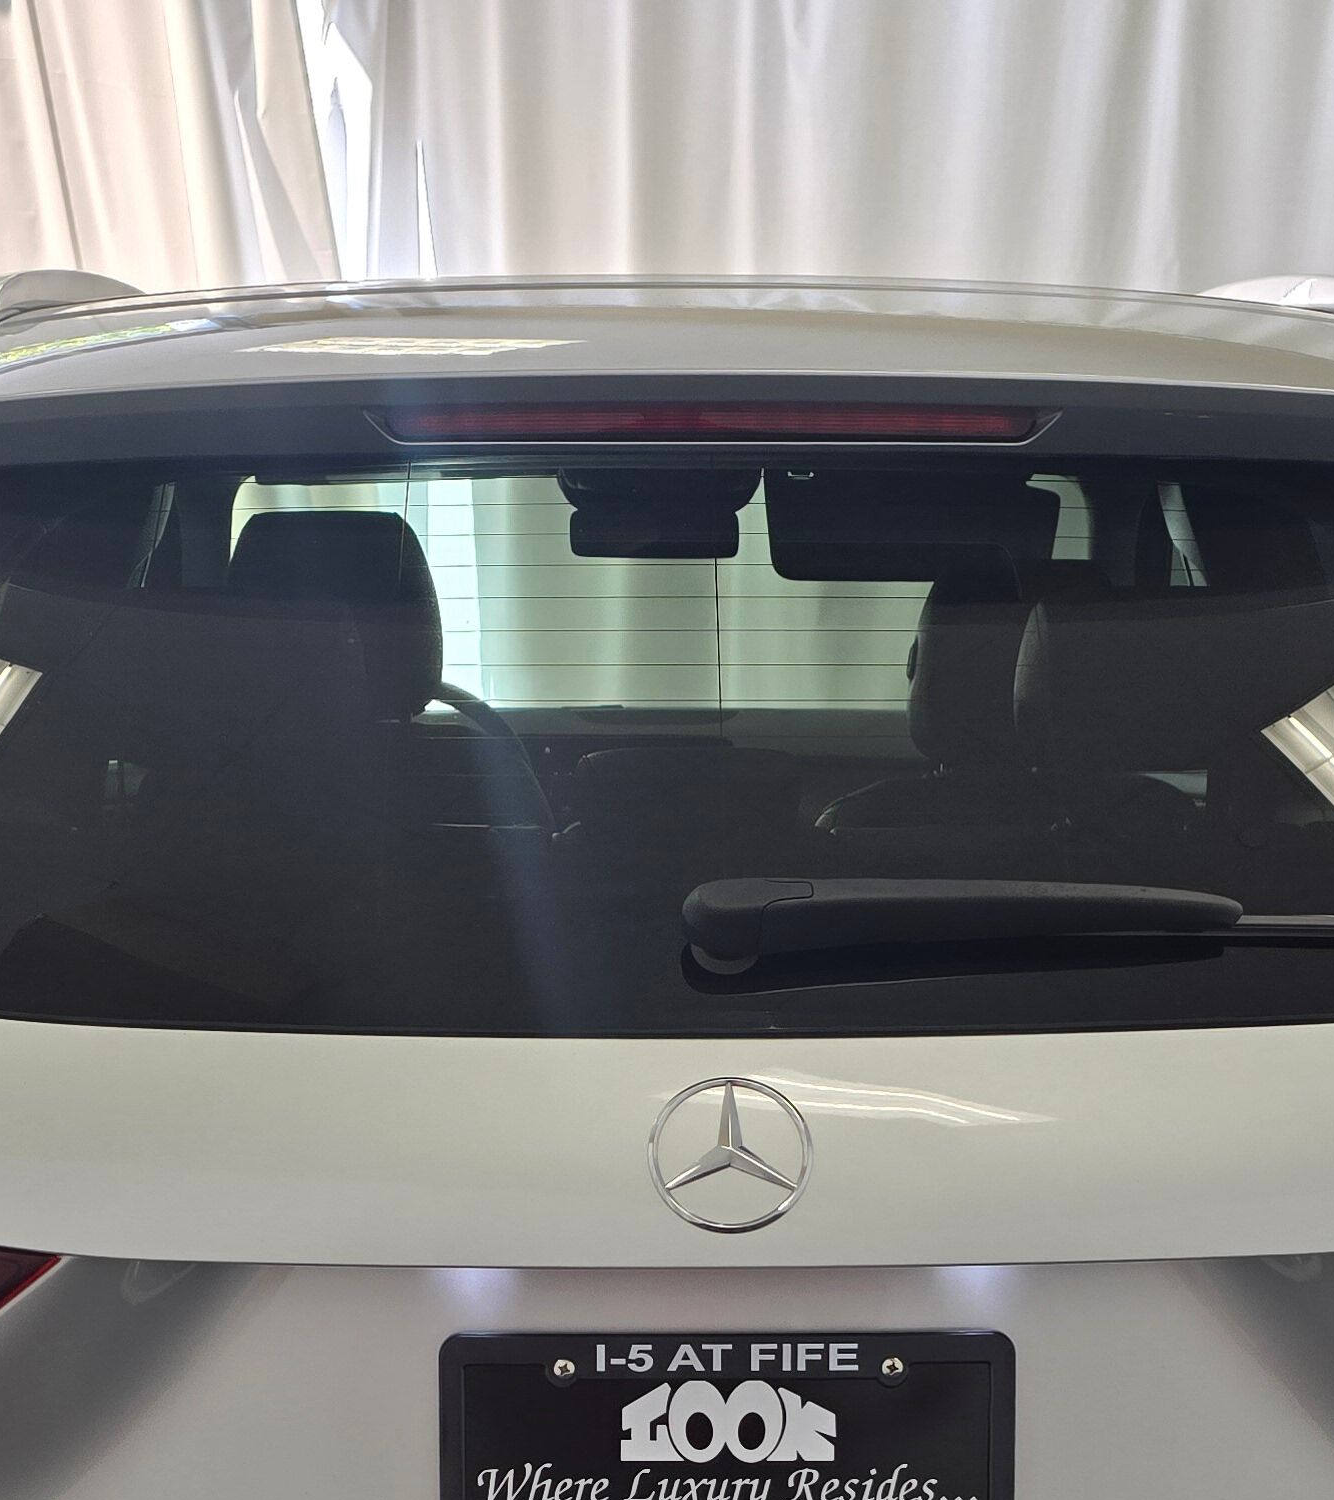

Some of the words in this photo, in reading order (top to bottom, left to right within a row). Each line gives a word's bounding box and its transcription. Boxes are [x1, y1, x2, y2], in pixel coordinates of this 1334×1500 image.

[596, 1344, 654, 1373] I-5
[667, 1344, 732, 1372] AT
[750, 1343, 859, 1372] FIFE
